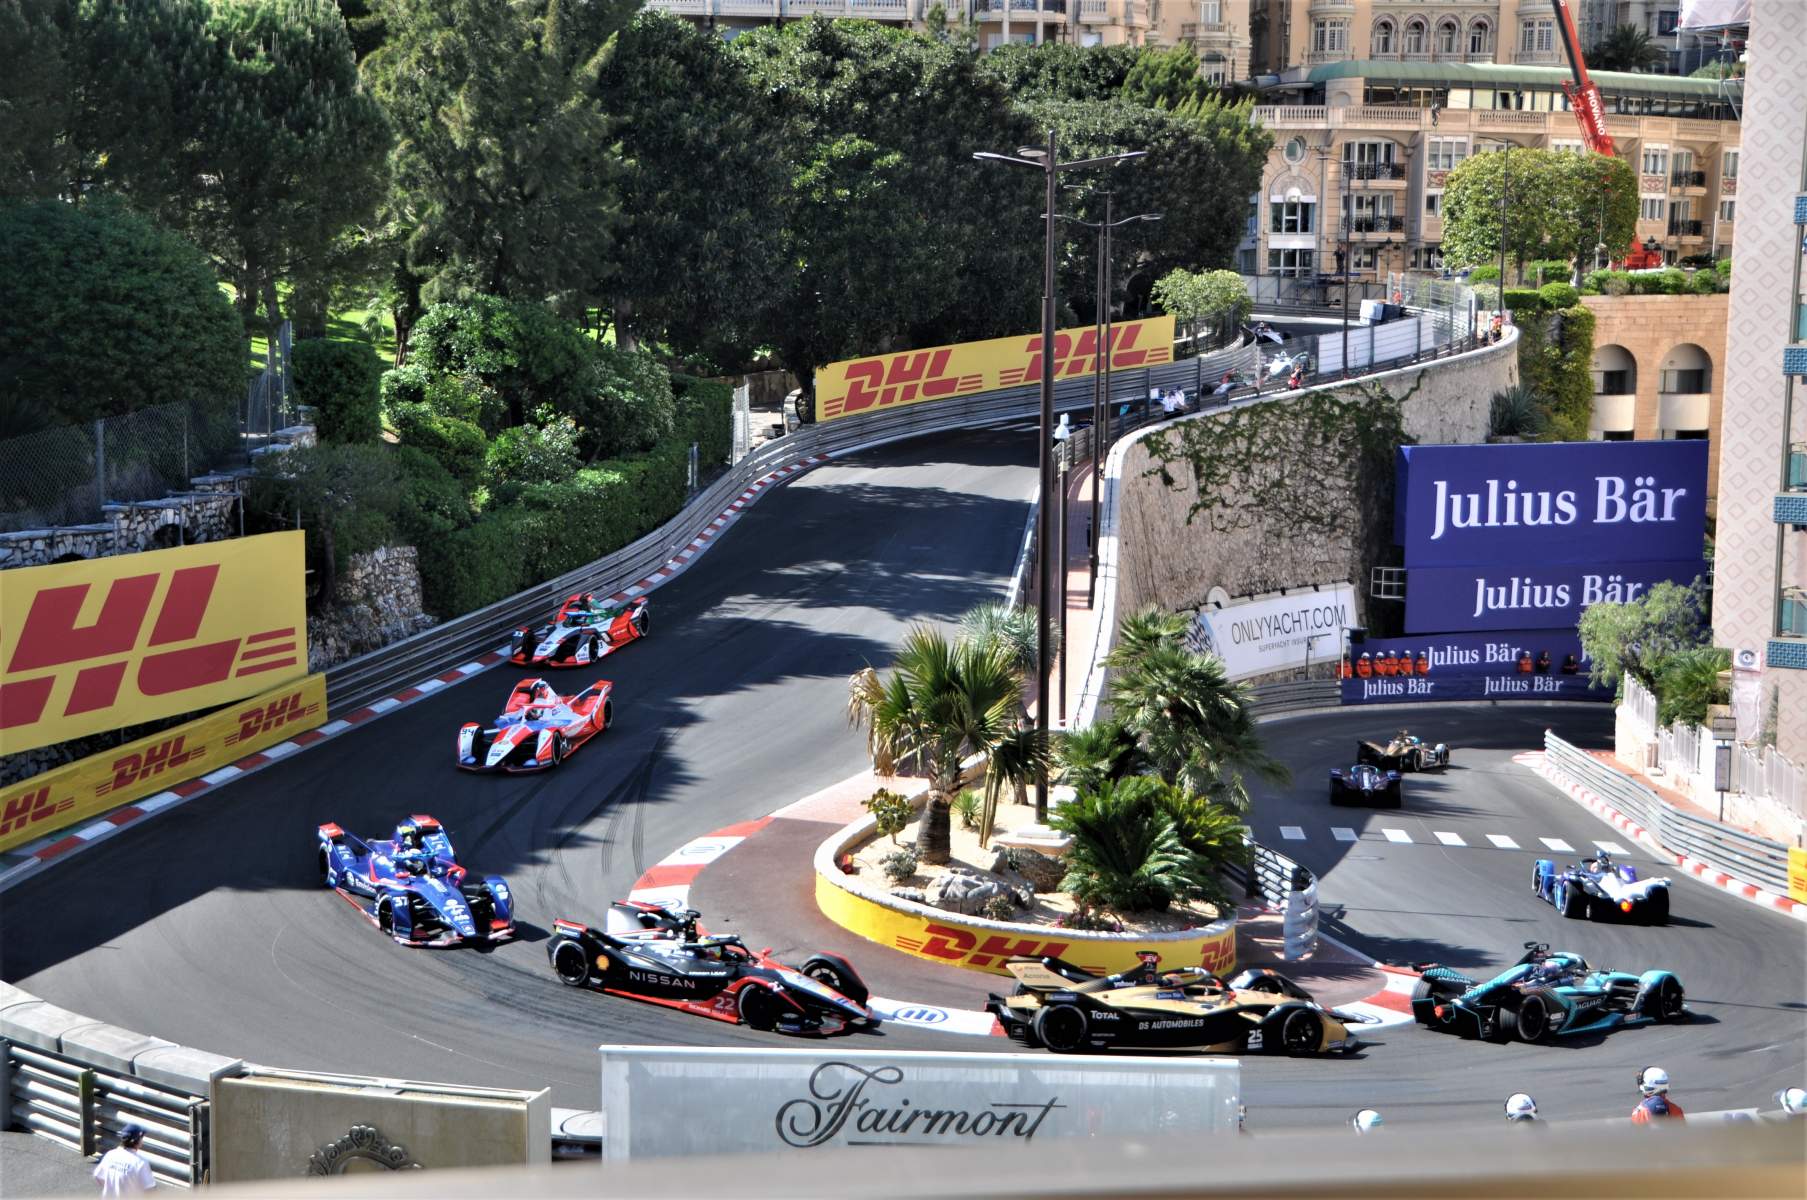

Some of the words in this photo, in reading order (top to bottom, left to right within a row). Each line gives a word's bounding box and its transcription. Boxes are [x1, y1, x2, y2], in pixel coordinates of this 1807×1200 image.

[1587, 89, 1606, 135] PIOVANO
[843, 349, 960, 412] DHL
[1430, 479, 1577, 540] Julius
[1592, 476, 1686, 523] Bär
[1473, 577, 1571, 618] Julius
[1580, 574, 1643, 606] Bär
[1231, 604, 1347, 645] ONLYYACHT.COM
[0, 563, 242, 729] HL
[1427, 645, 1479, 670] Julius
[1485, 643, 1521, 664] Bär
[1363, 679, 1403, 700] Julius
[1407, 677, 1435, 695] Bär
[1484, 676, 1528, 696] Julius
[1533, 675, 1564, 693] Bär
[238, 692, 306, 742] DHL
[111, 735, 192, 790] DHL
[0, 785, 58, 837] HL
[629, 971, 696, 989] NISSAN
[714, 996, 736, 1010] 22
[1090, 1010, 1119, 1020] TOTAL
[1138, 1022, 1149, 1030] DS
[1151, 1019, 1205, 1030] AUTOMOBILES
[1247, 1029, 1263, 1043] 25
[775, 1061, 1067, 1148] Fairmont
